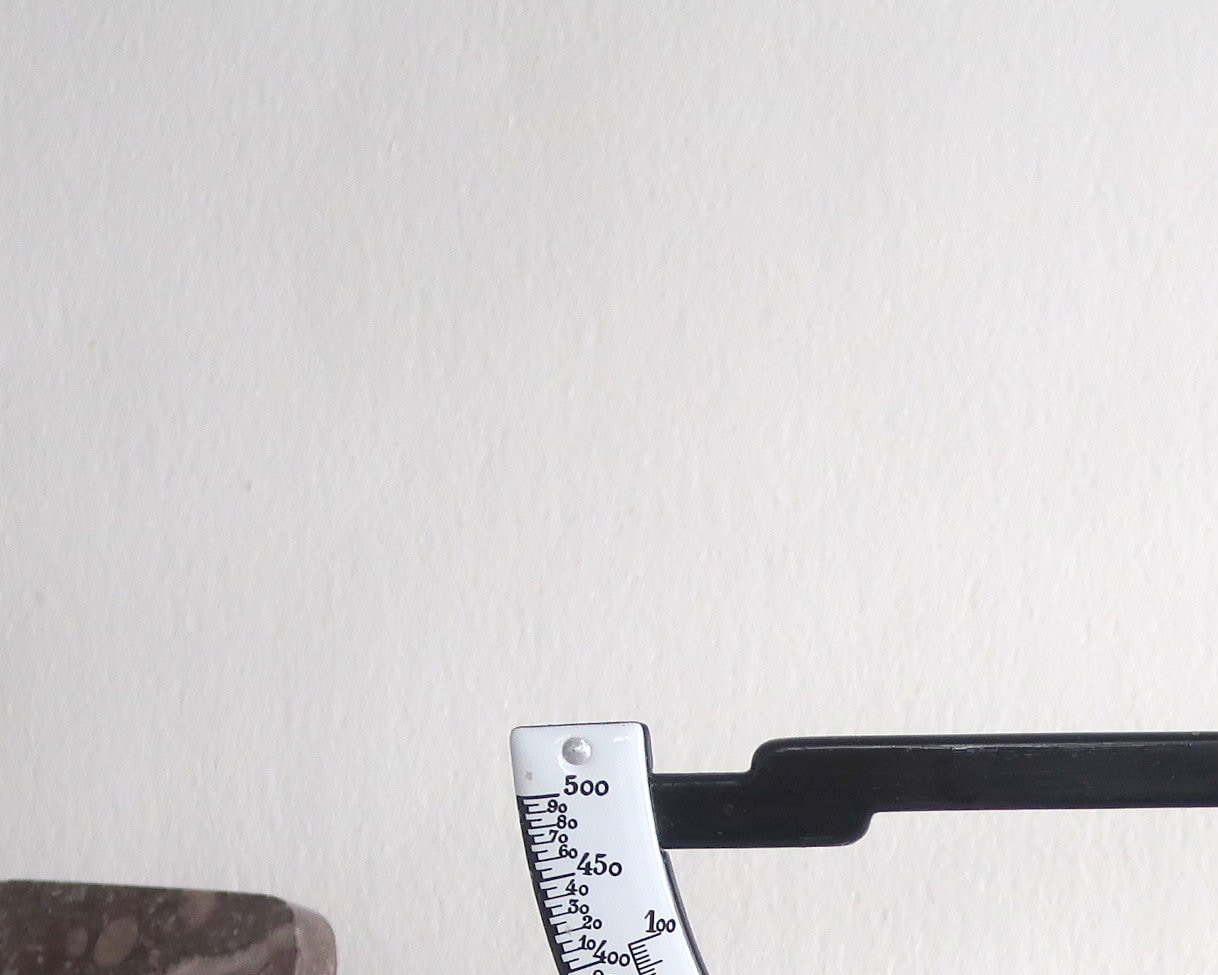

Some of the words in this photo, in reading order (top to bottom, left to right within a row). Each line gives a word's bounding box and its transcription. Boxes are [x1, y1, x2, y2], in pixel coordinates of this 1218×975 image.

[563, 775, 609, 796] 500
[546, 799, 567, 814] 90
[556, 814, 578, 830] 80
[549, 830, 568, 844] 70
[558, 844, 578, 859] 60
[577, 852, 622, 877] 450
[565, 879, 589, 896] 40
[568, 899, 589, 915] 30
[582, 915, 602, 930] 20
[644, 910, 676, 933] 100
[578, 935, 596, 950] 10
[593, 940, 630, 967] 400
